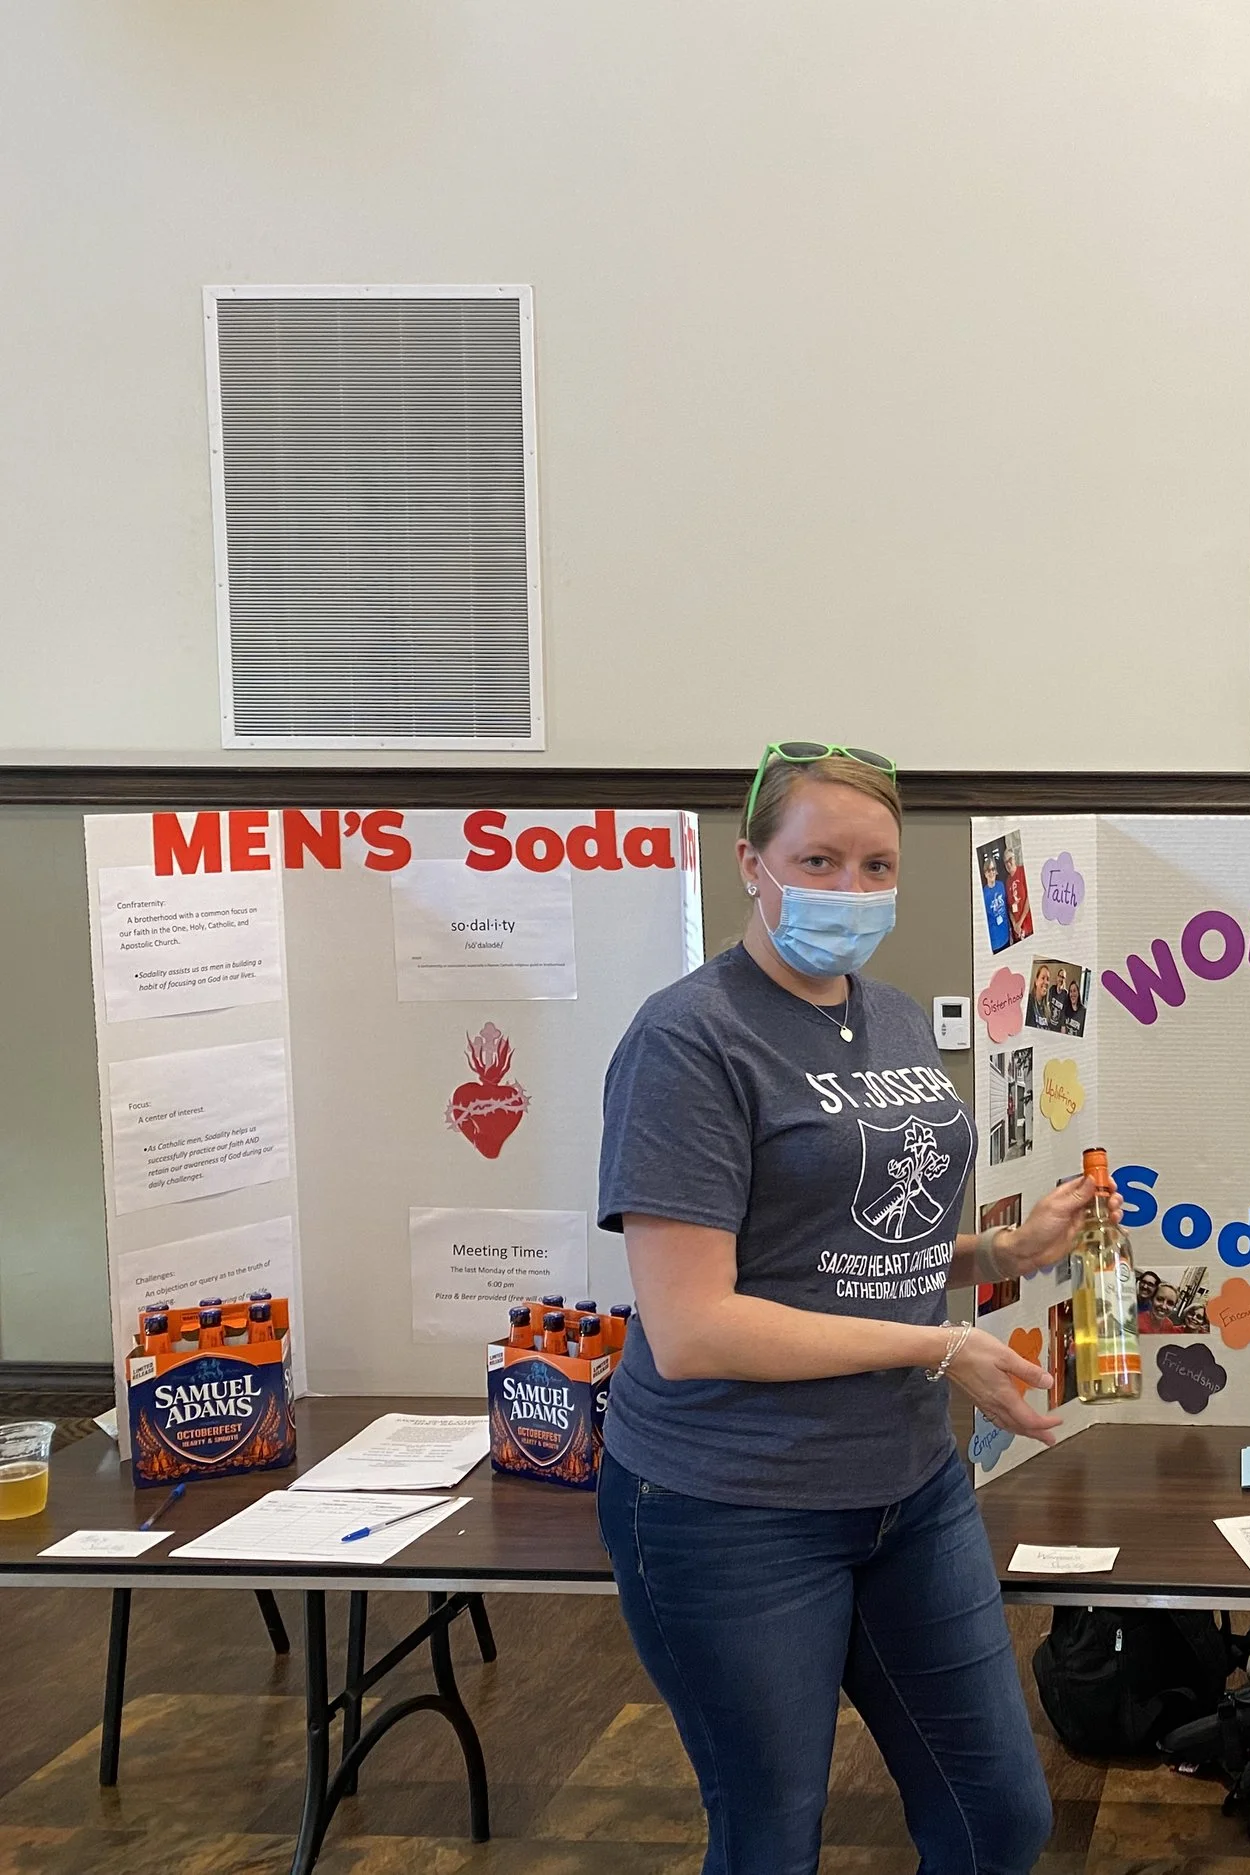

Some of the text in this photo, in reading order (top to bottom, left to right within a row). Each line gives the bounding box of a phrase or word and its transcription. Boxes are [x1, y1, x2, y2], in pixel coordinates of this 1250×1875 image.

[152, 809, 412, 876] MEN'S
[1047, 869, 1077, 908] Faith
[117, 900, 165, 910] Confraternity:
[134, 913, 178, 924] brotherhood
[179, 912, 194, 920] with
[200, 909, 230, 918] common
[133, 928, 150, 937] faith
[159, 926, 171, 934] the
[172, 925, 189, 933] One,
[190, 923, 207, 932] Holy,
[120, 938, 180, 950] Apostolic Church.
[139, 970, 167, 979] Sodality
[168, 968, 190, 976] assists
[232, 960, 256, 968] building
[139, 983, 158, 991] habit
[159, 981, 167, 990] of
[167, 979, 196, 990] focusing
[207, 975, 221, 983] God
[983, 992, 1023, 1015] Sisterhood
[851, 1066, 964, 1108] JOSEPH
[1045, 1079, 1076, 1113] Uplifting
[128, 1102, 151, 1110] Focus:
[145, 1113, 168, 1123] center
[169, 1111, 176, 1119] of
[147, 1145, 156, 1153] As
[157, 1140, 185, 1151] Catholic
[187, 1137, 203, 1145] men,
[204, 1131, 230, 1142] Sodality
[231, 1127, 248, 1137] helps
[147, 1136, 260, 1165] successfully practice our faith AND
[148, 1167, 169, 1177] retain
[170, 1164, 183, 1172] our
[183, 1158, 219, 1170] awareness
[220, 1155, 228, 1164] of
[228, 1152, 241, 1160] God
[242, 1148, 262, 1158] during
[148, 1172, 204, 1189] daily challenges.
[452, 1244, 548, 1260] Meeting Time:
[817, 1241, 955, 1277] SACRED HEART CATHEDRA
[135, 1270, 176, 1285] Challenges:
[156, 1283, 189, 1295] objection
[199, 1275, 218, 1285] query
[228, 1270, 235, 1278] to
[235, 1266, 247, 1275] the
[247, 1263, 263, 1272] truth
[264, 1259, 271, 1268] of
[478, 1267, 506, 1276] Monday
[506, 1267, 515, 1275] of
[487, 1280, 502, 1288] 6:00
[836, 1271, 947, 1299] CATHEDRAL KIDS CAMP
[435, 1292, 452, 1300] Pizza
[477, 1294, 507, 1302] provided
[508, 1295, 524, 1303] (free
[132, 1362, 153, 1374] LIMITED
[132, 1367, 154, 1380] RELEASE
[155, 1374, 261, 1409] SAMUEL
[503, 1377, 575, 1411] SAMUEL
[165, 1397, 253, 1429] ADAMS
[510, 1402, 569, 1430] ADAMS
[177, 1423, 242, 1440] OCTOBERFEST
[517, 1426, 562, 1443] OCTOBERFEST
